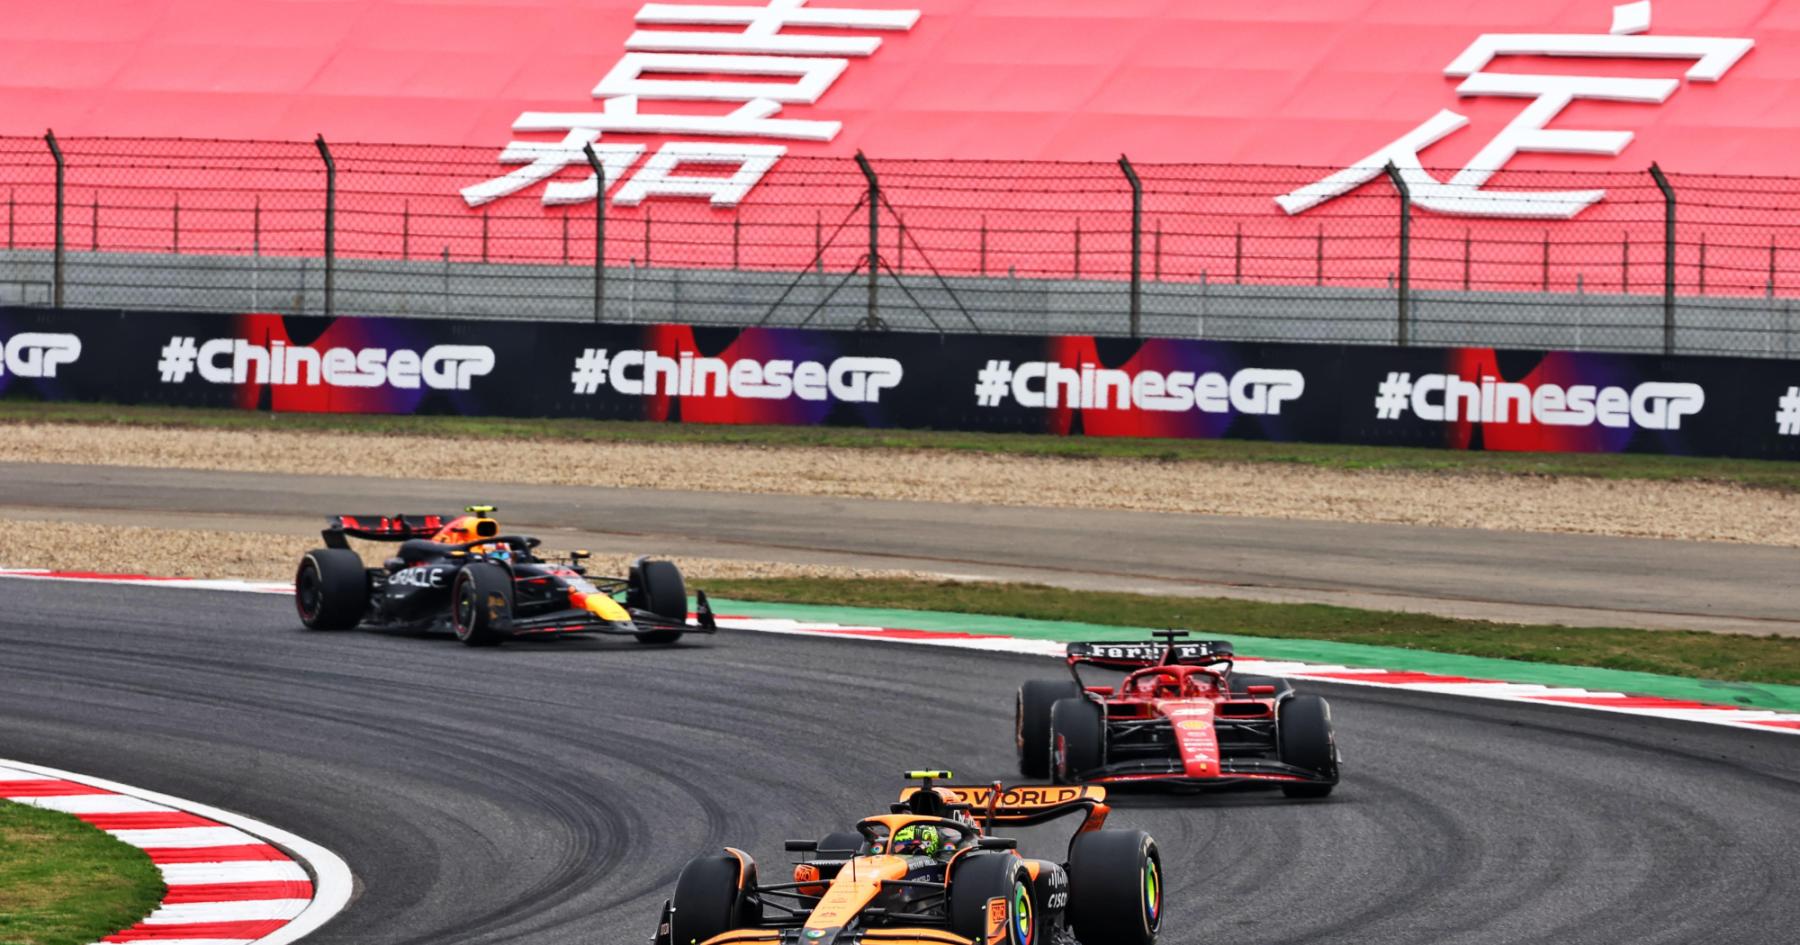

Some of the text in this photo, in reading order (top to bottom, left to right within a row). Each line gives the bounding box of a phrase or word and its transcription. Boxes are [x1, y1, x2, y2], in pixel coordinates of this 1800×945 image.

[0, 332, 82, 378] GP
[158, 336, 495, 390] #ChineseGP
[572, 348, 903, 402] #ChineseGP
[976, 359, 1305, 415] #ChineseGP
[1375, 371, 1705, 430] #ChineseGP
[388, 567, 444, 588] ORACLE
[1091, 643, 1209, 658] Ferrri
